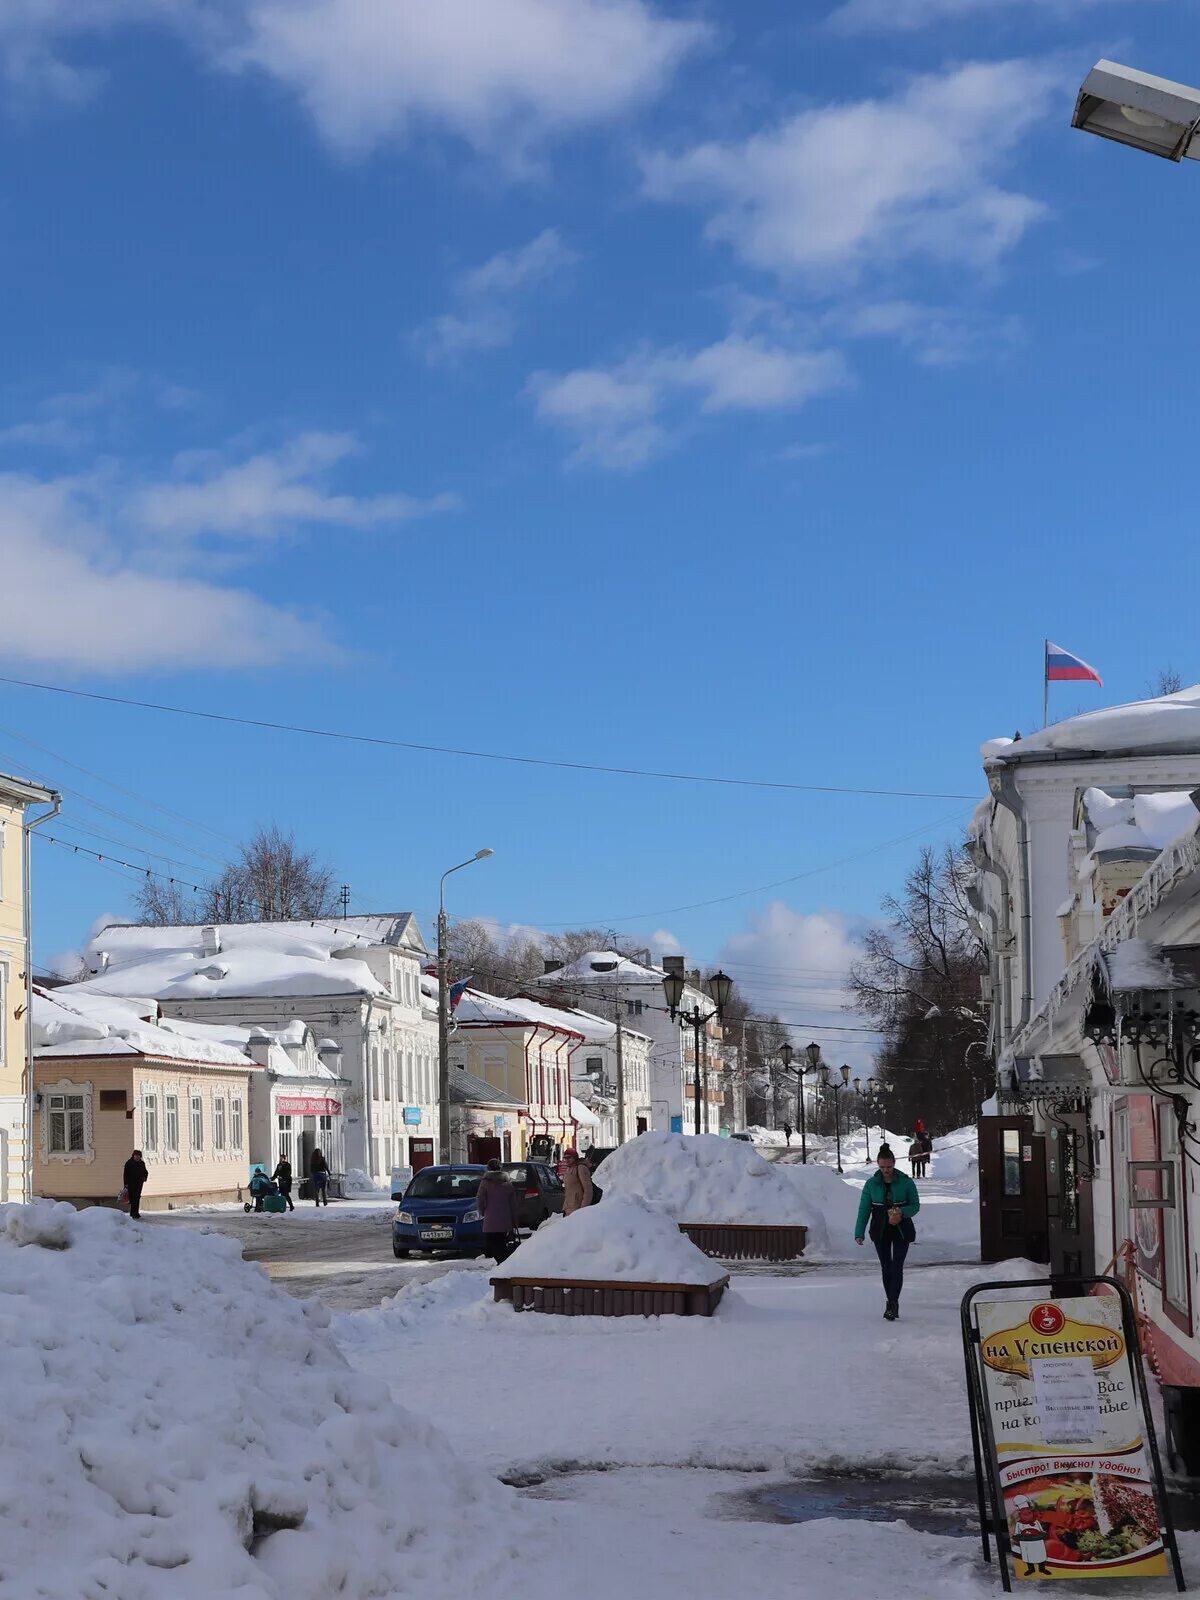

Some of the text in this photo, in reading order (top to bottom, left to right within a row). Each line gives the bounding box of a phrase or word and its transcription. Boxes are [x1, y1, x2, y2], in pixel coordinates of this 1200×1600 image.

[1098, 1381, 1125, 1394] Вас
[1024, 1415, 1041, 1427] ко
[1099, 1400, 1130, 1415] ные
[1006, 1462, 1050, 1481] Быстро!
[1054, 1460, 1095, 1471] Вкусно!
